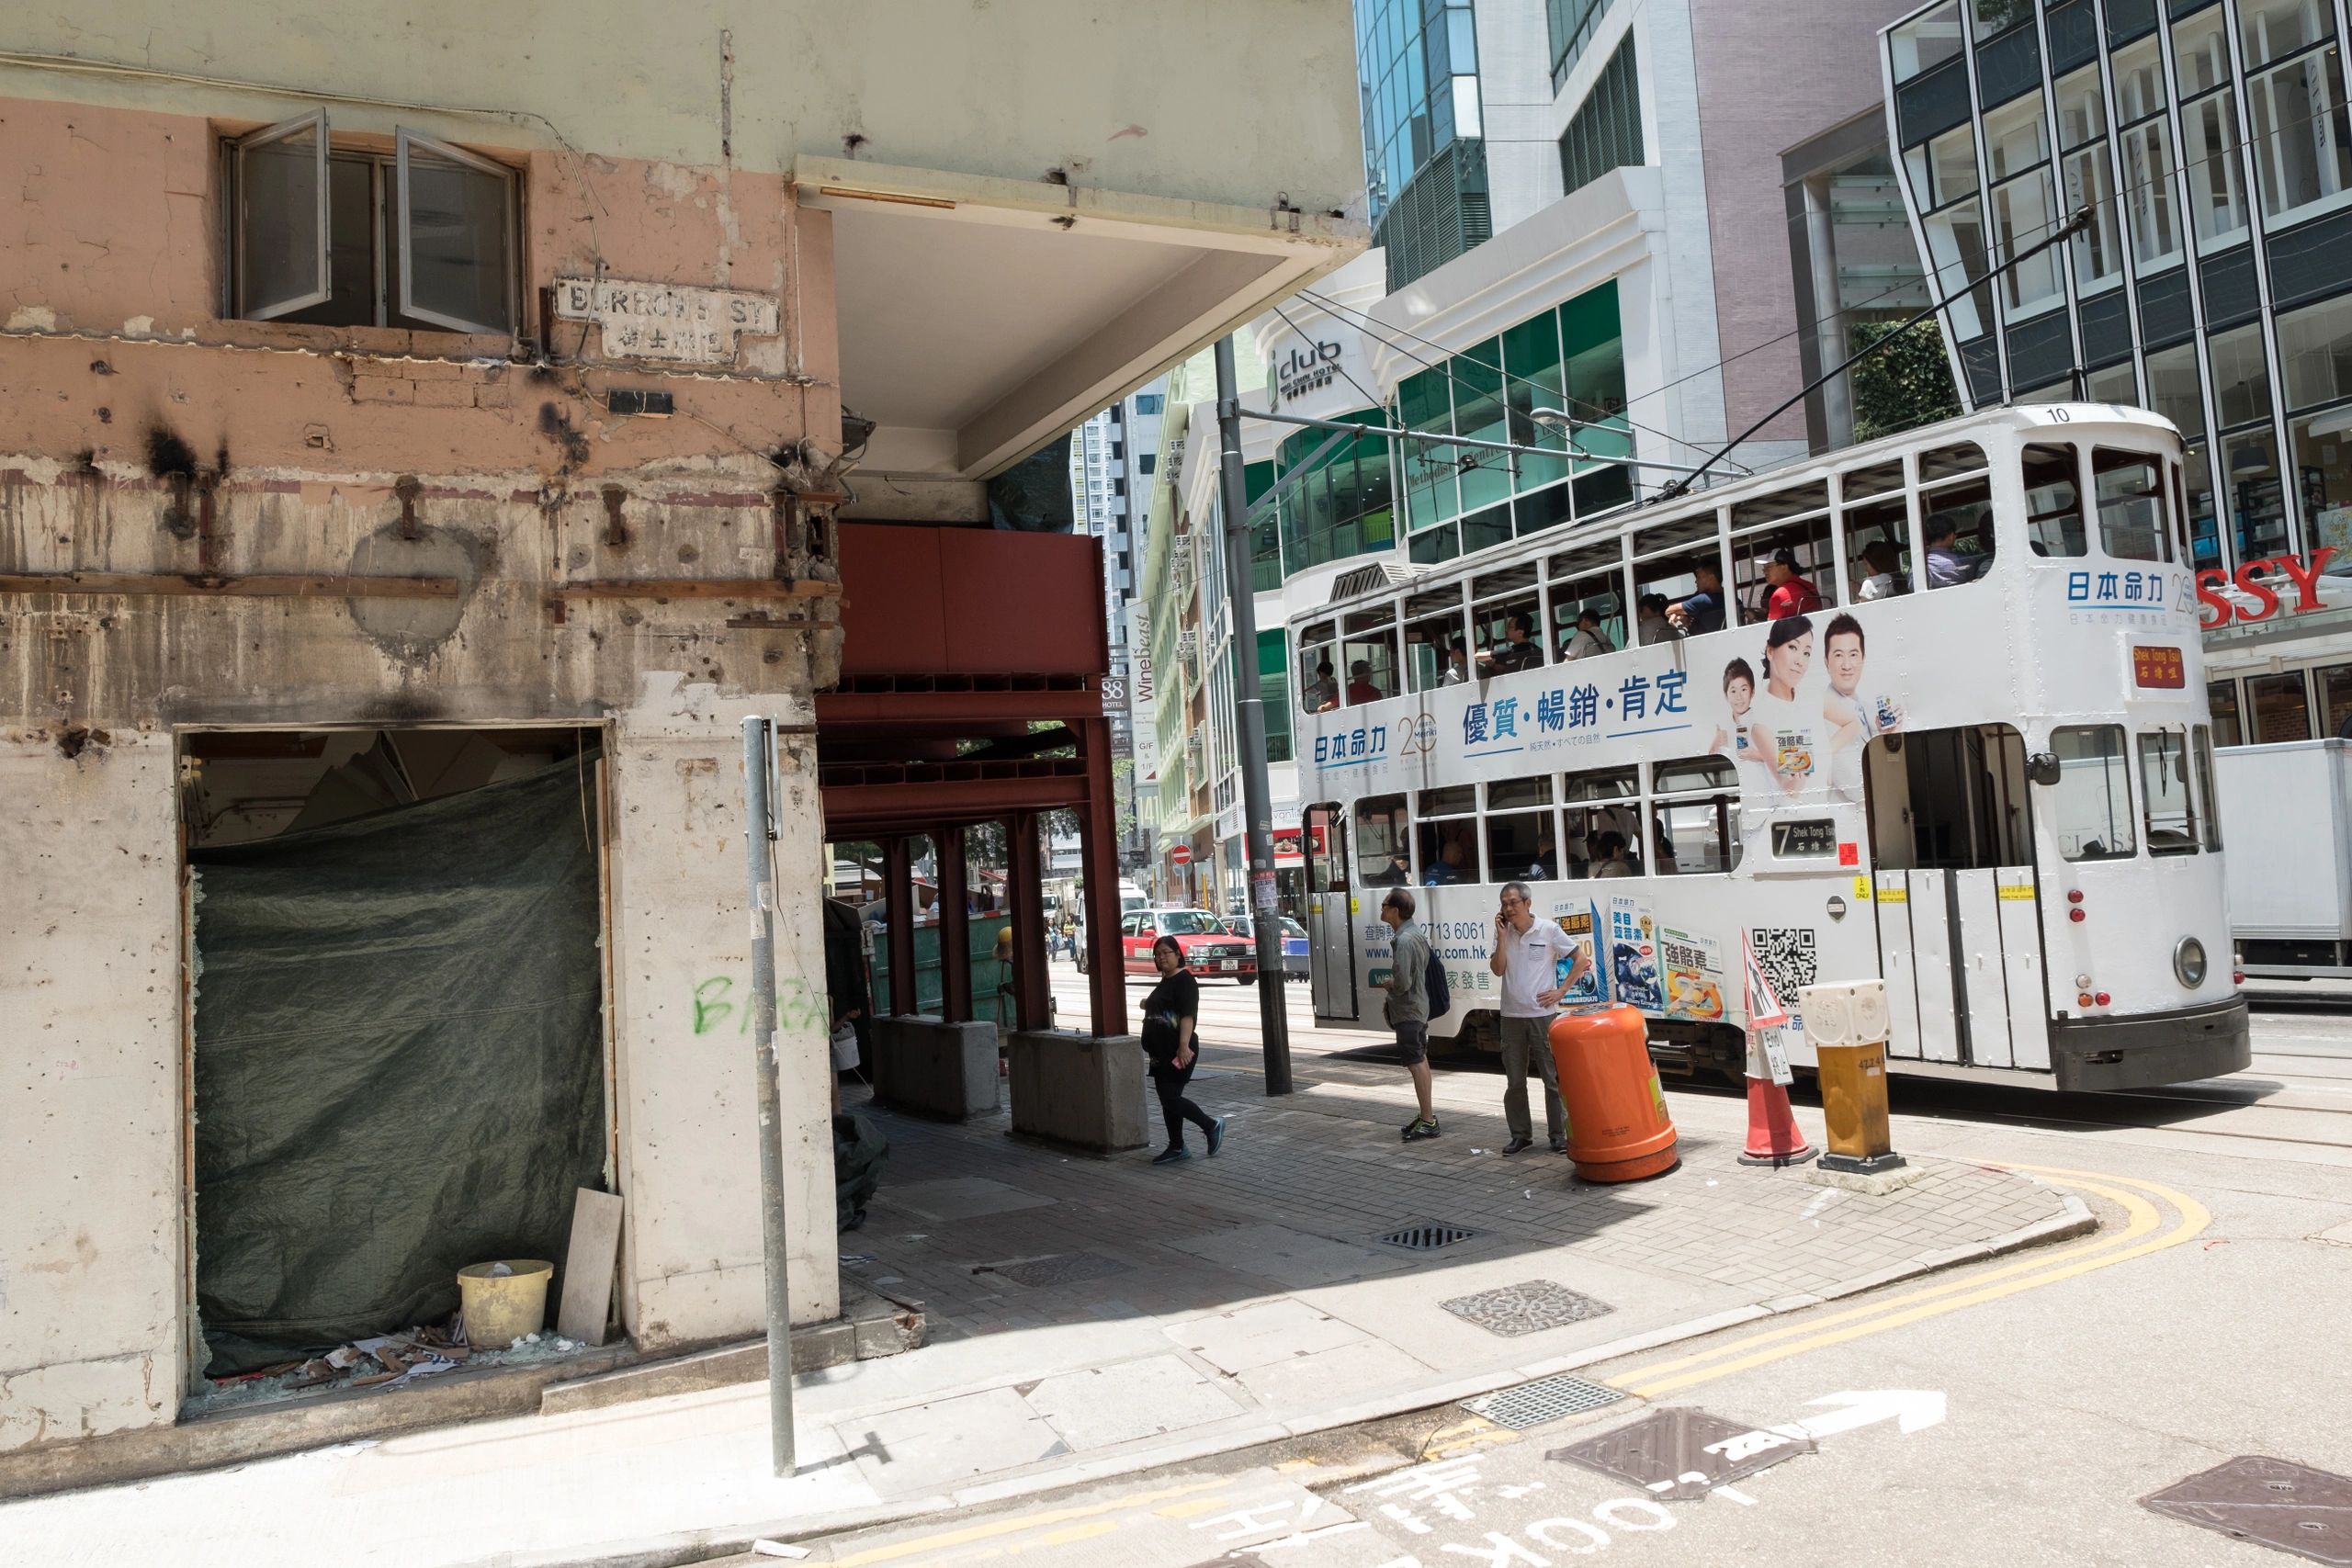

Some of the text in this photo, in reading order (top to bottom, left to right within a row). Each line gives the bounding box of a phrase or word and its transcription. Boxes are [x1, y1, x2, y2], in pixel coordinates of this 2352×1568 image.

[2047, 408, 2071, 423] 10
[2068, 571, 2163, 603] 日本命力
[2134, 648, 2150, 661] Shek
[1315, 726, 1385, 763] 日本命力
[1138, 795, 1159, 825] 141
[1775, 825, 1792, 855] 7
[1792, 827, 1808, 838] Shek
[1809, 826, 1825, 839] Tong
[1454, 922, 1486, 940] 6061
